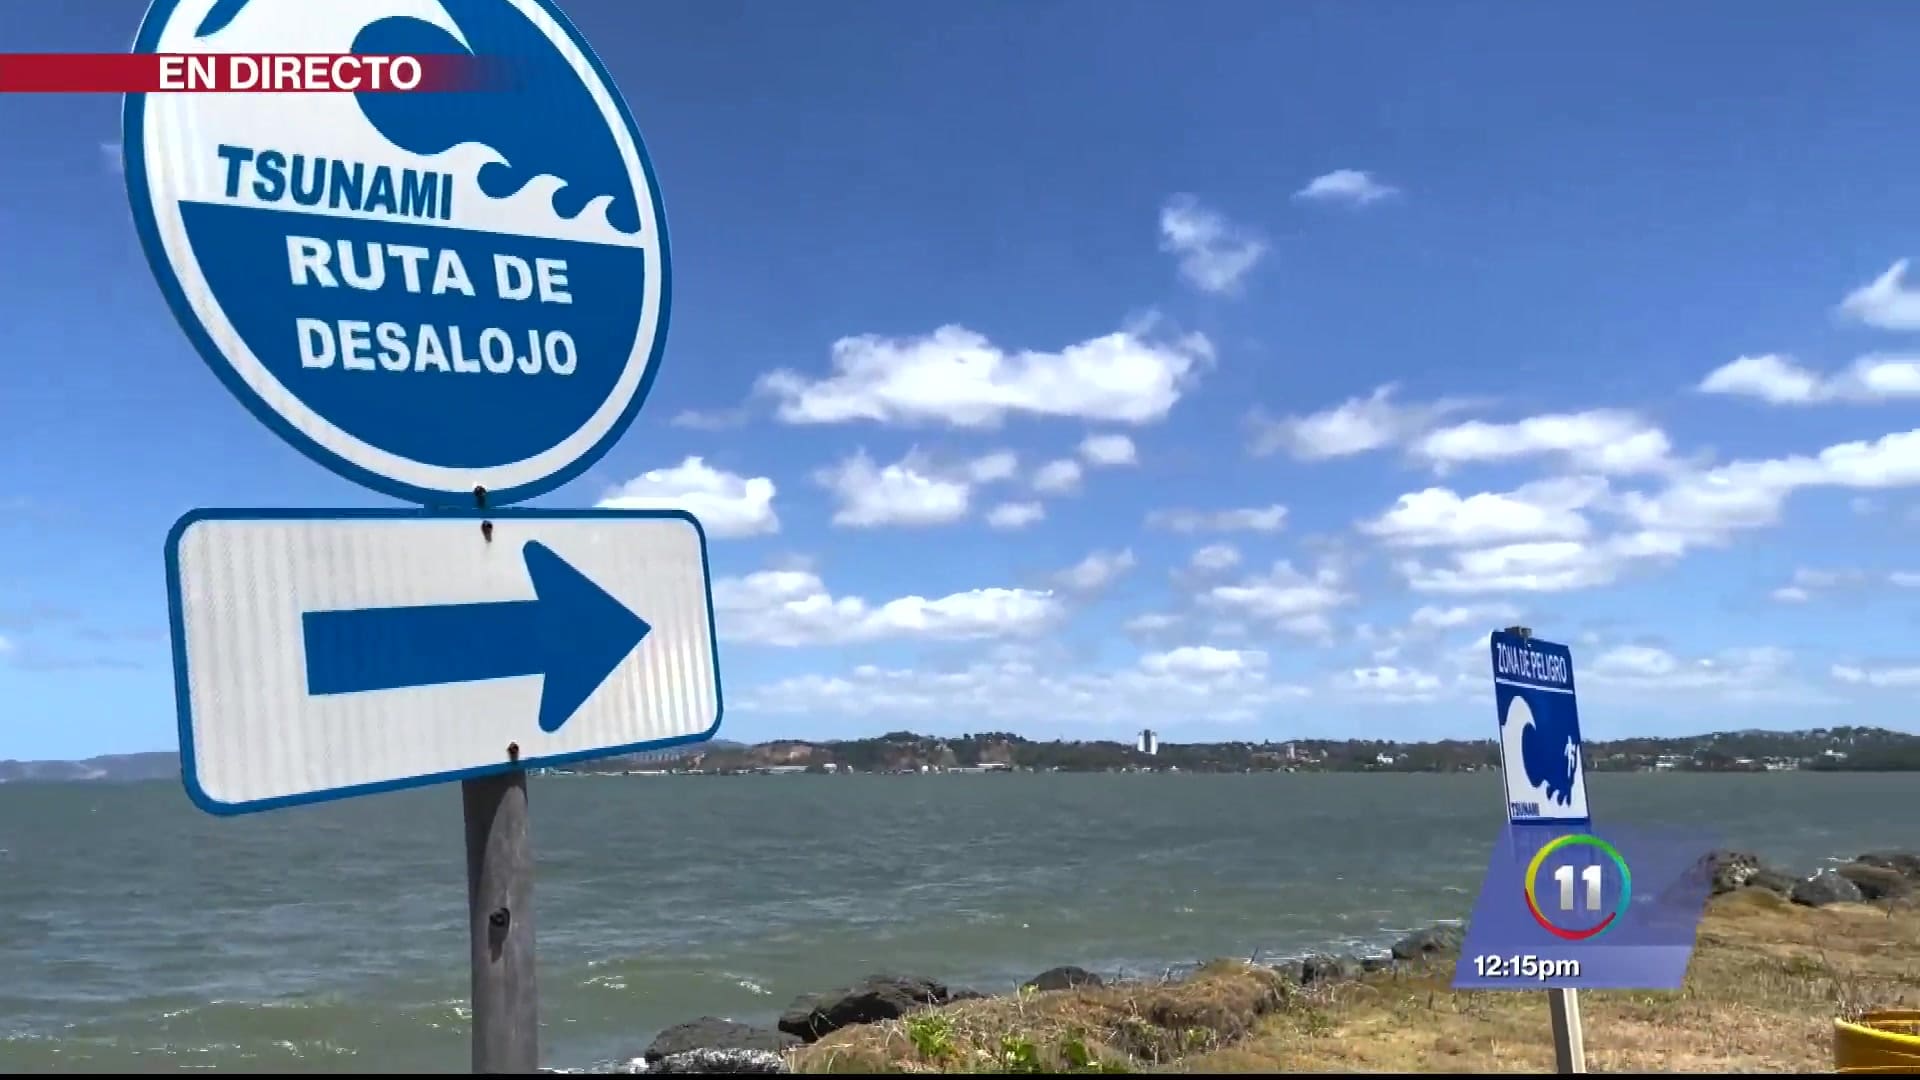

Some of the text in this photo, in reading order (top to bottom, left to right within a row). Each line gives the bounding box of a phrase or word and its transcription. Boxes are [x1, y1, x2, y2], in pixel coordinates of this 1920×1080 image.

[218, 145, 453, 220] TSUNAMI
[286, 235, 573, 304] RUTA DE
[296, 318, 578, 376] DESALOJO
[1496, 642, 1568, 684] ZONA DE PELIGRO
[1511, 802, 1540, 817] TSUNAMI
